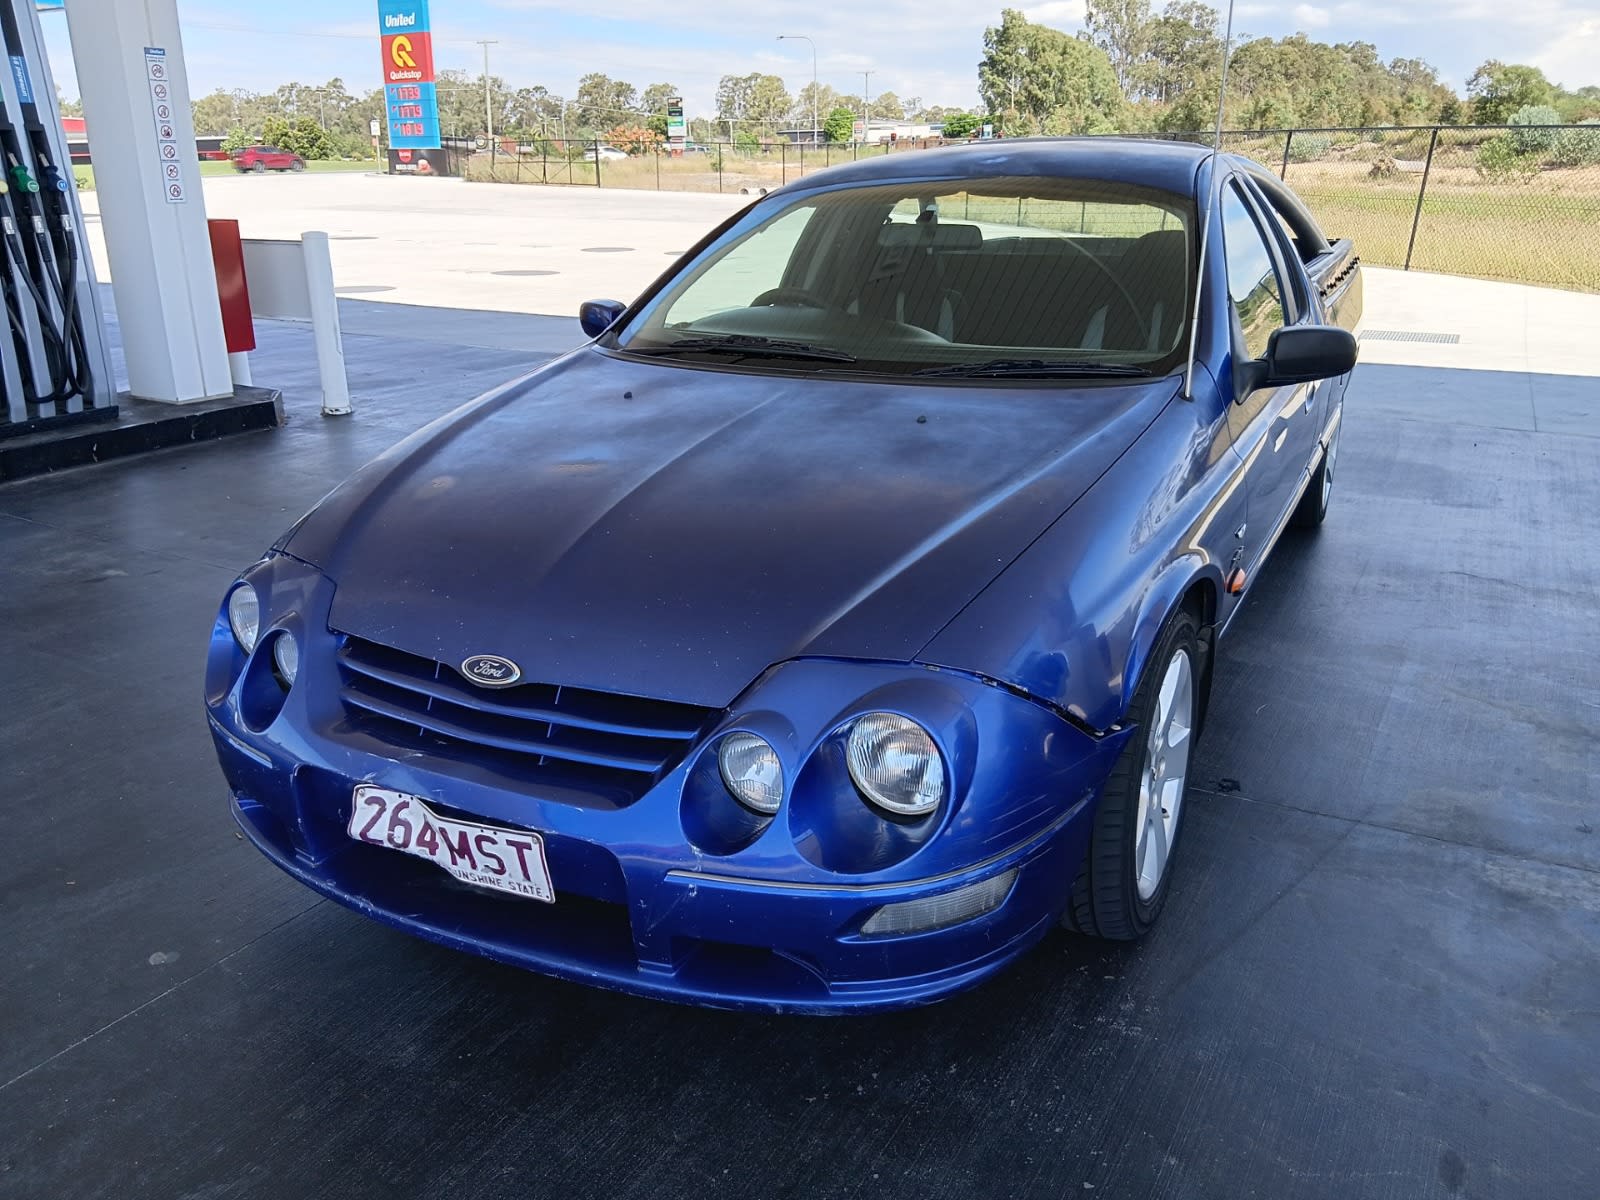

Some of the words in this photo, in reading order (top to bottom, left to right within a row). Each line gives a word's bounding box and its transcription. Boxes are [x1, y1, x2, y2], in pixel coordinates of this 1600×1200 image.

[385, 13, 415, 28] United
[390, 71, 422, 81] Quickstop
[473, 660, 506, 677] Ford
[453, 870, 504, 887] UNSHINE
[508, 881, 543, 897] STATE
